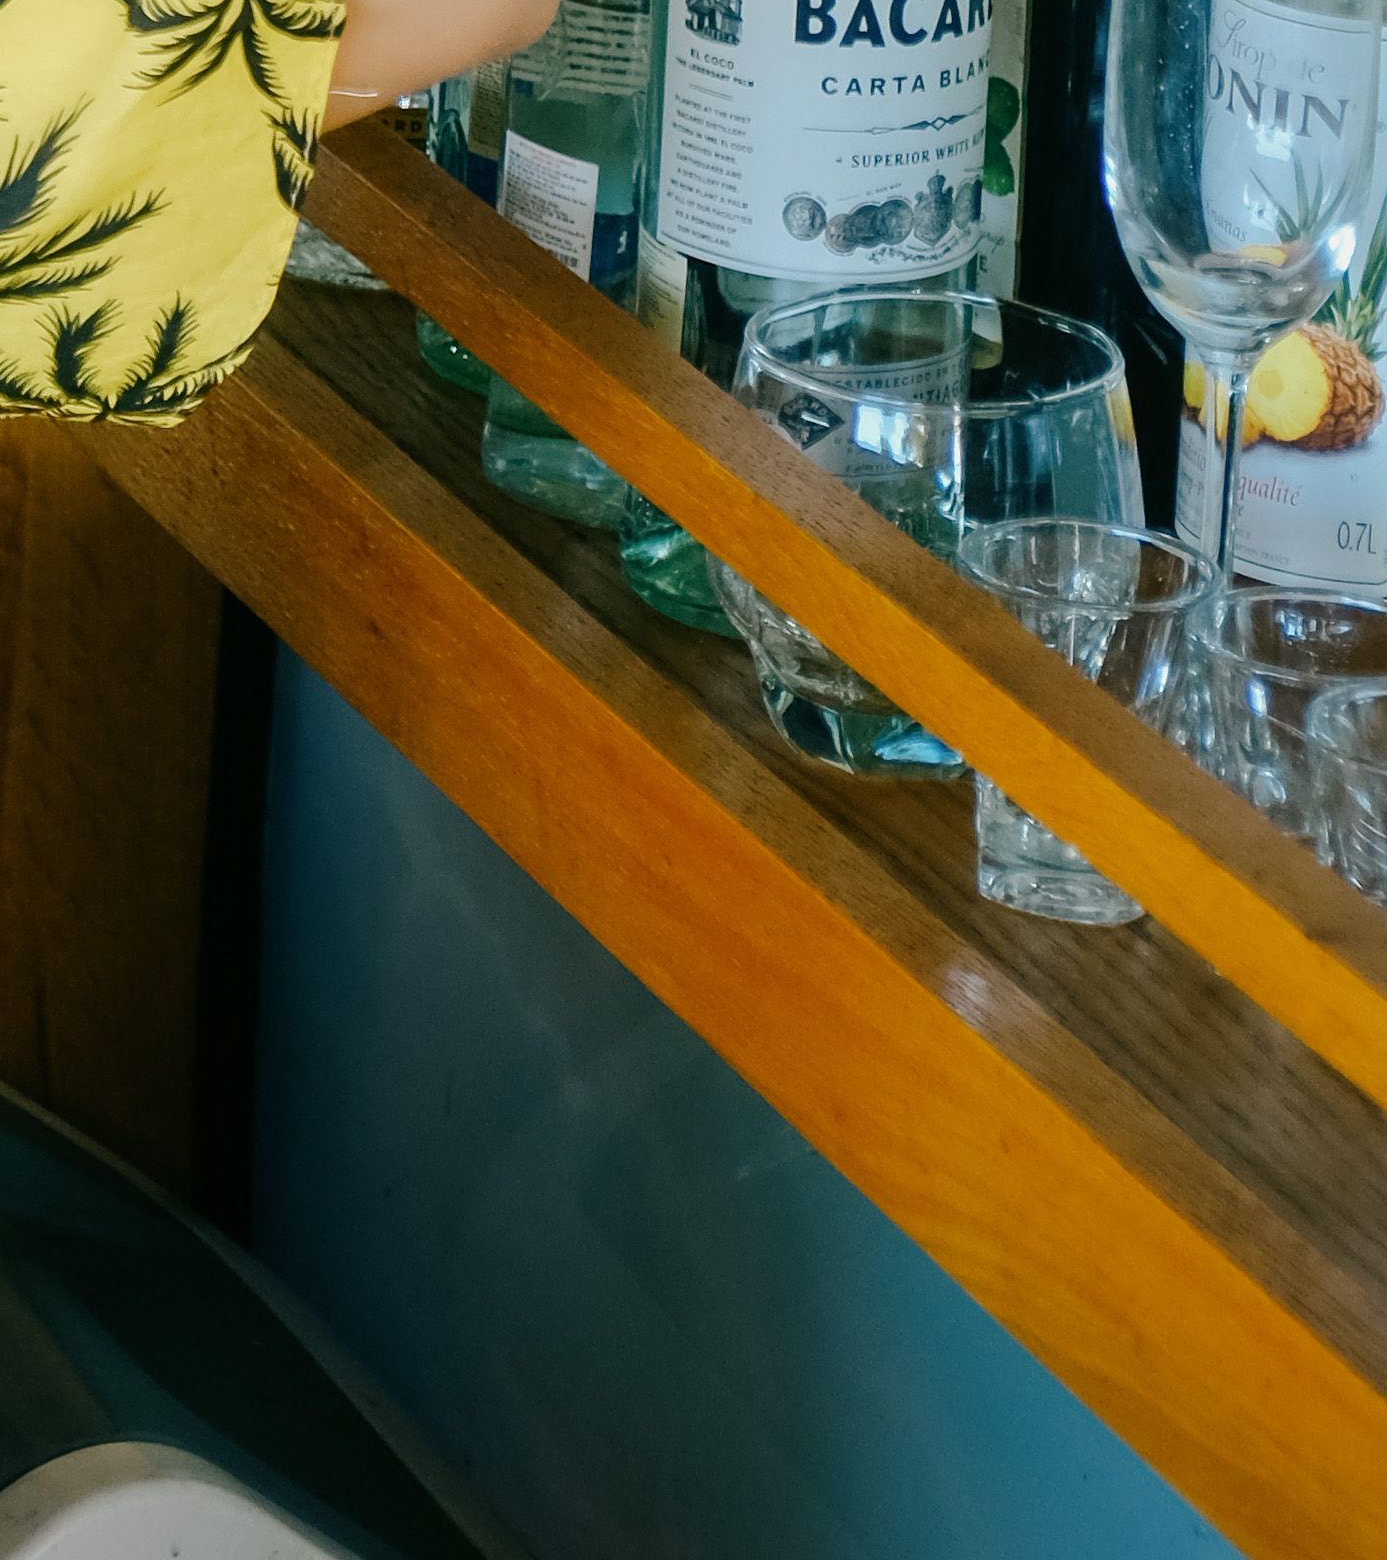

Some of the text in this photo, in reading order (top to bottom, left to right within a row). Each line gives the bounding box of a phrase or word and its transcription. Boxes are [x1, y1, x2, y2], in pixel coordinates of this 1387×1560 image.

[704, 53, 735, 71] COCO
[821, 74, 926, 96] CARTA
[851, 150, 931, 169] SUPERIOR
[1237, 476, 1304, 507] qualité
[1337, 520, 1378, 555] 0.7L
